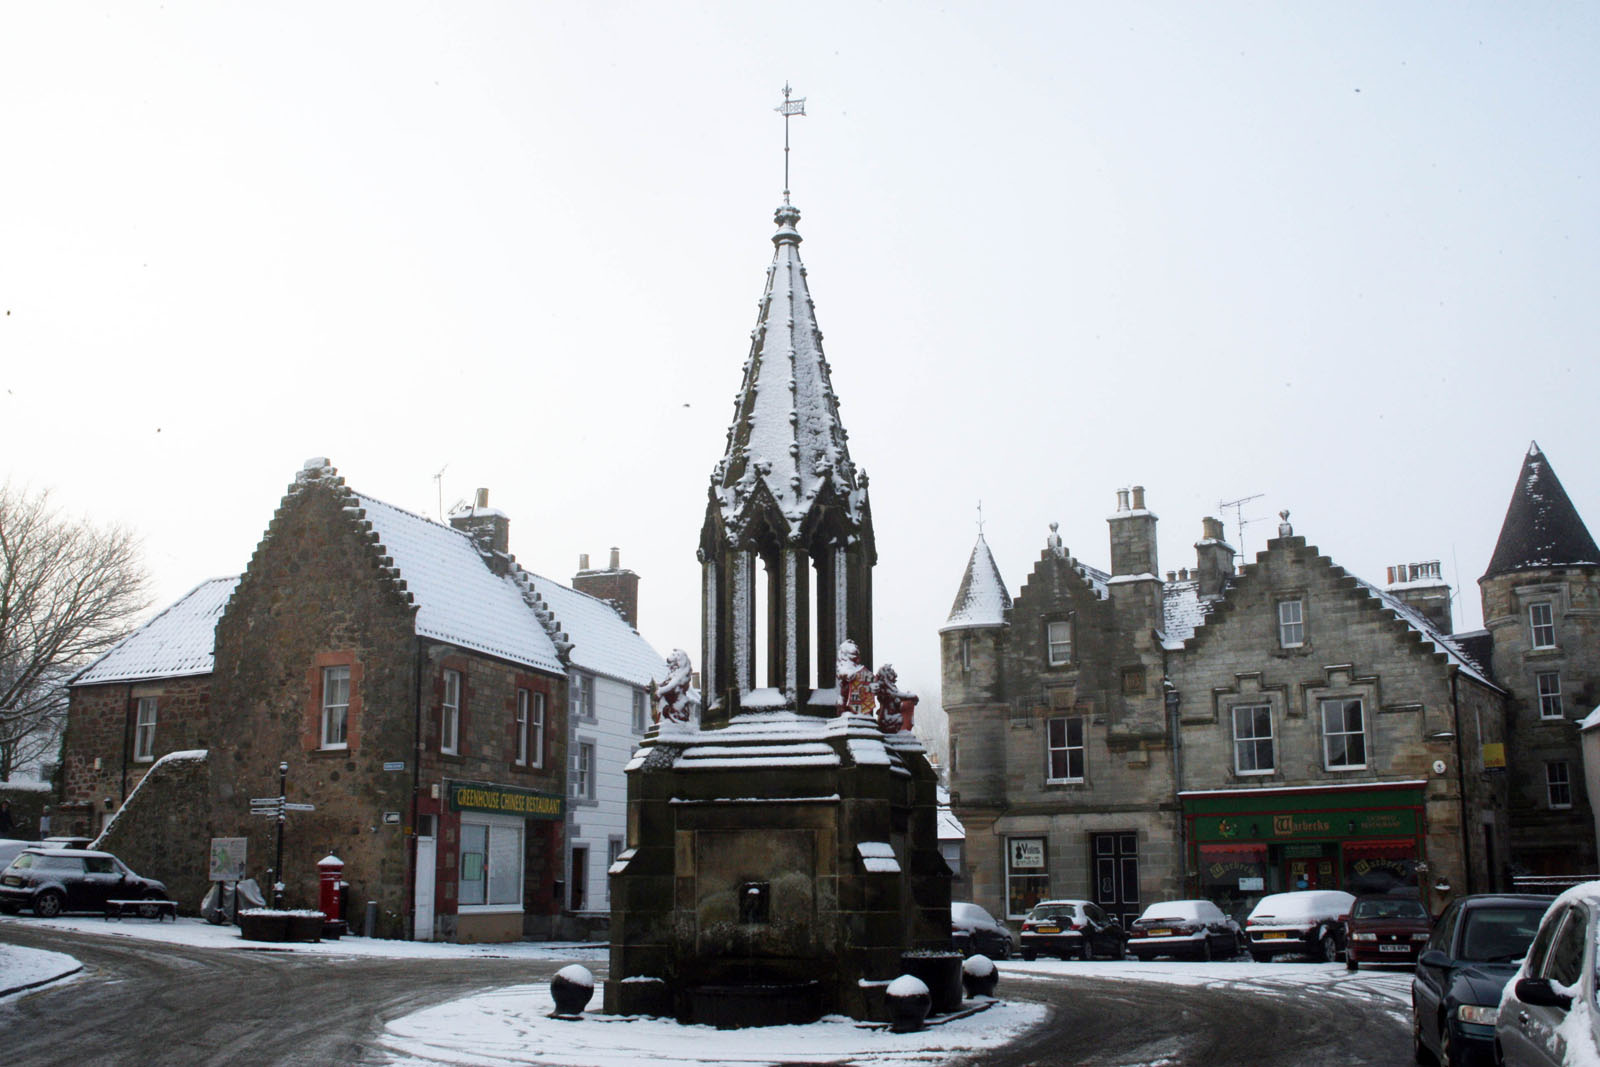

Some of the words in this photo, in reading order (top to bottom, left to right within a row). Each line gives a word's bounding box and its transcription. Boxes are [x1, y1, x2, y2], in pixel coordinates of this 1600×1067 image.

[458, 789, 500, 809] GREENHOUSE
[501, 793, 525, 811] CHINESE
[527, 796, 561, 815] RESTAURANT
